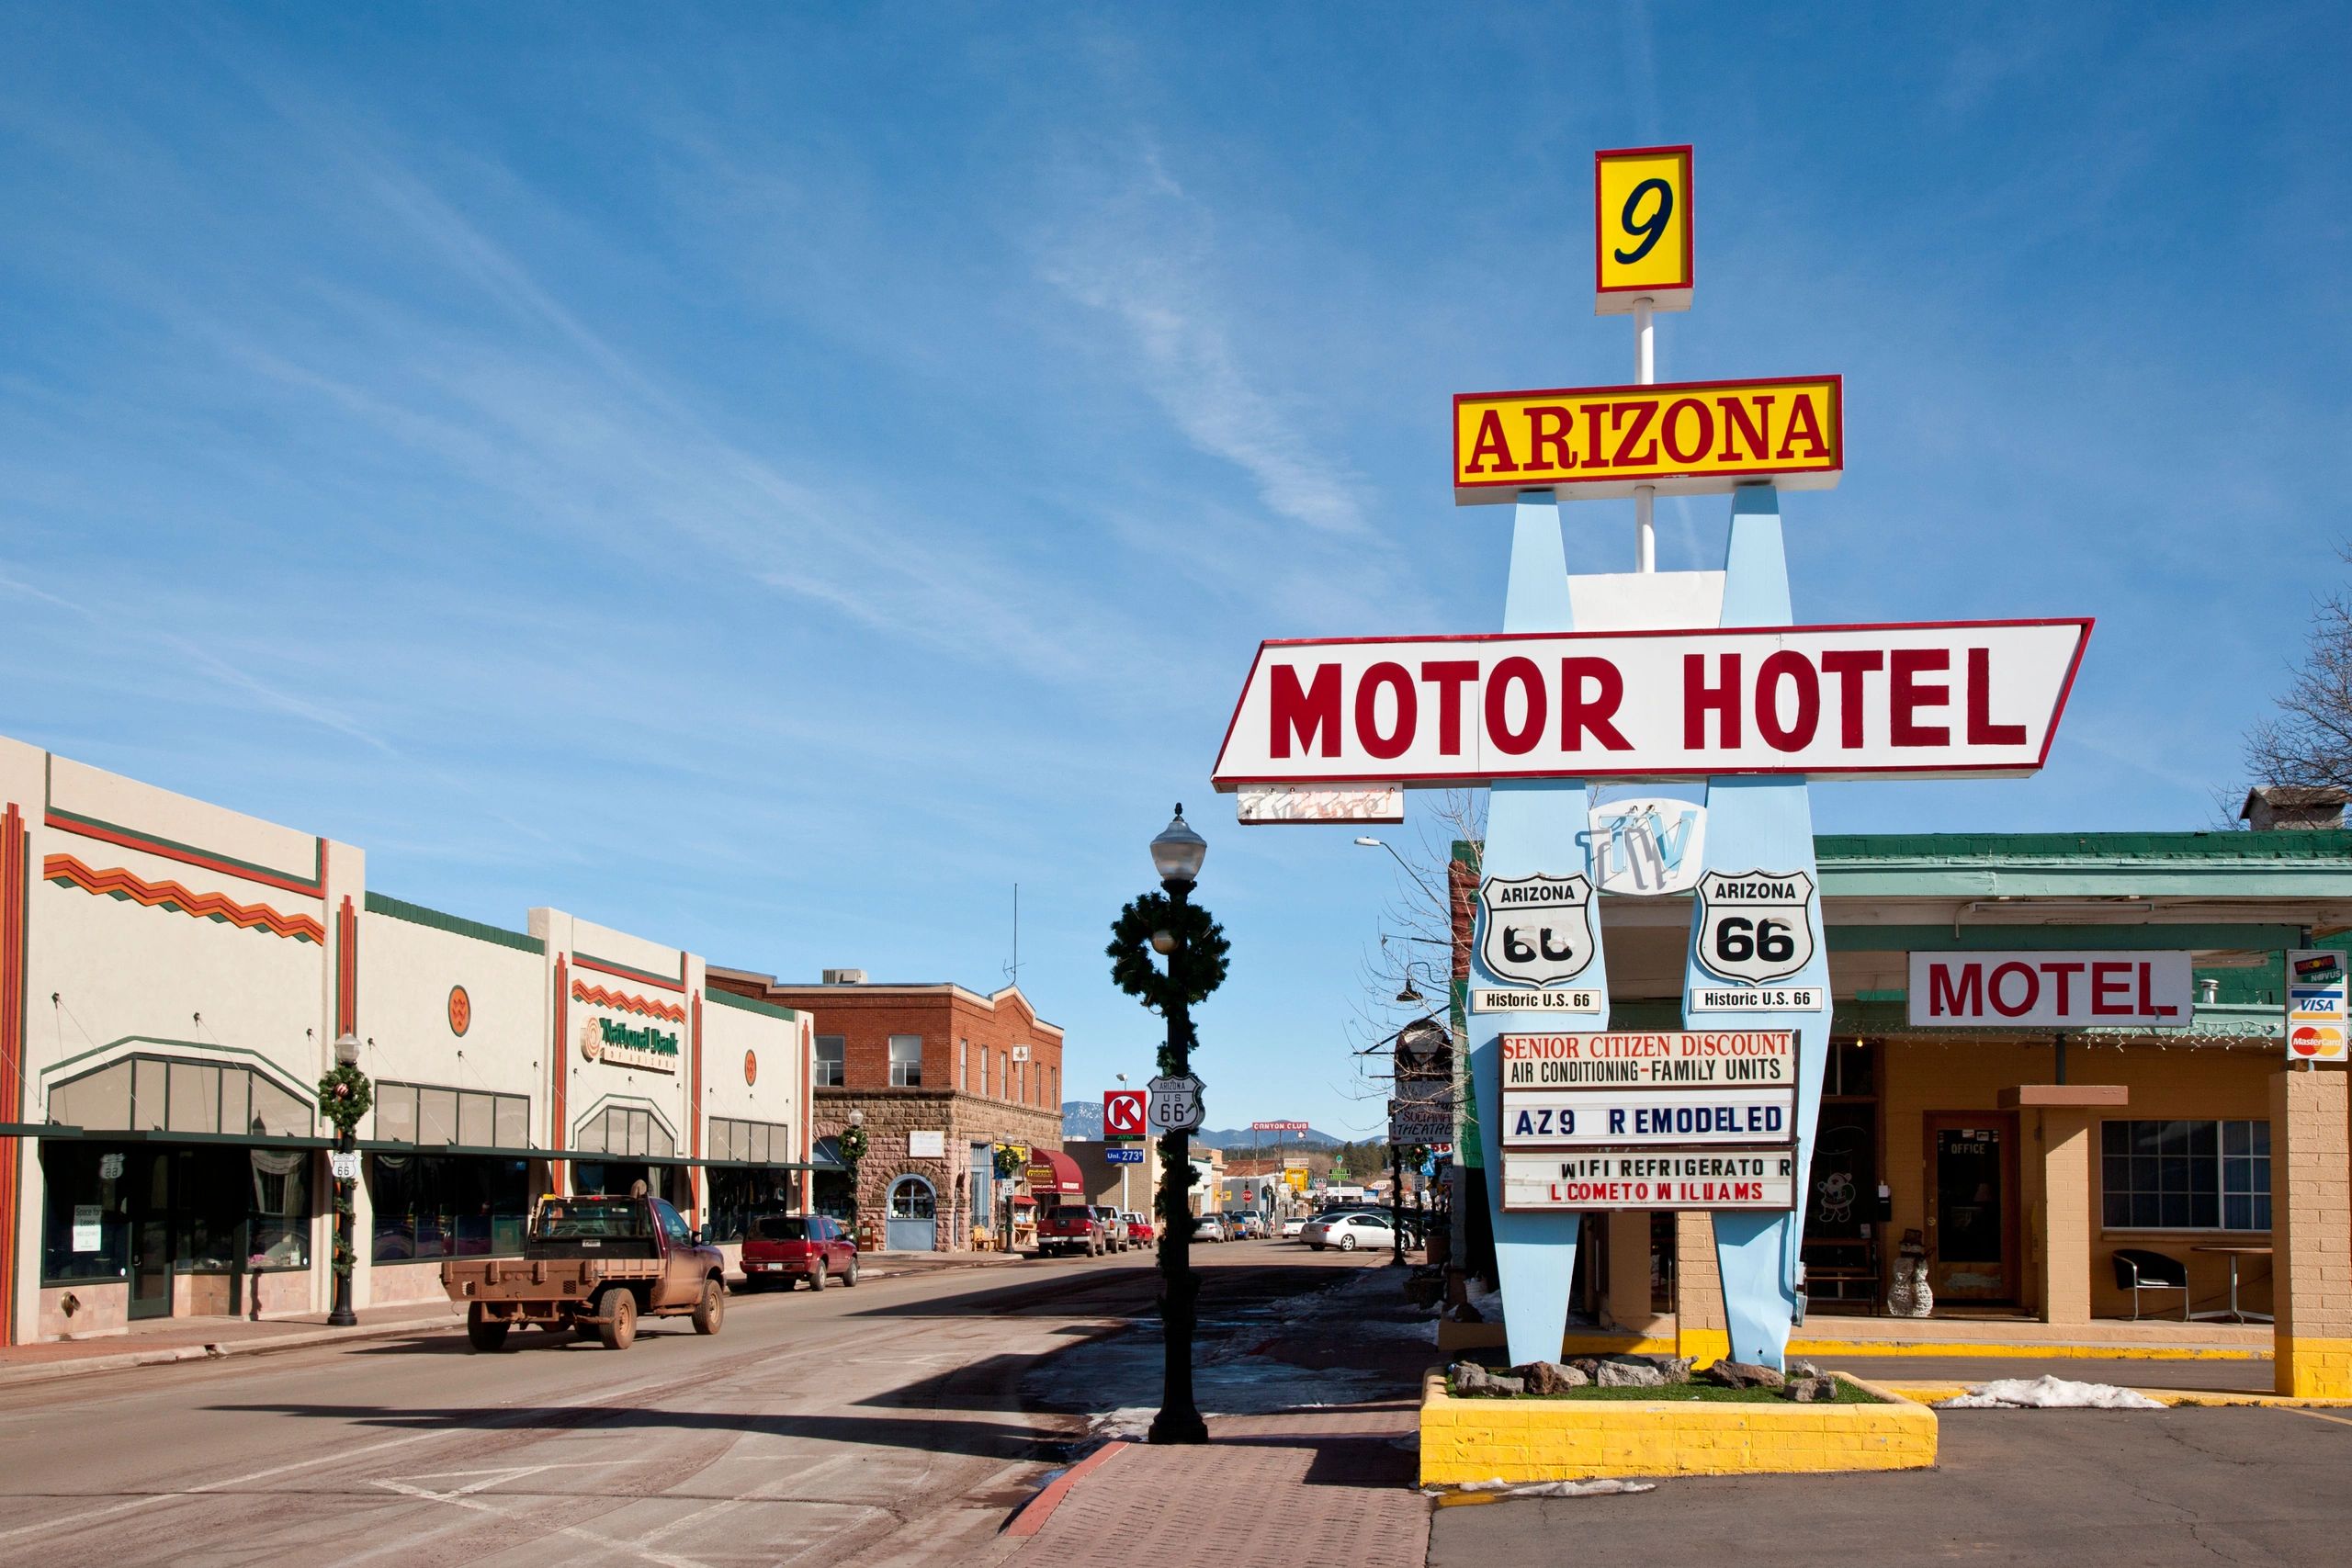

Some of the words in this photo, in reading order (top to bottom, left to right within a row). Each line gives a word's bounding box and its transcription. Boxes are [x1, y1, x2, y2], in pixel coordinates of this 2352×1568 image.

[1614, 178, 1673, 265] 9
[1464, 393, 1830, 474] ARIZONA
[1271, 656, 1635, 759] MOTOR
[1684, 648, 2027, 752] HOTEL
[1500, 886, 1575, 903] ARIZONA
[1714, 883, 1796, 899] ARIZONA
[1716, 917, 1794, 962] 66
[1705, 992, 1758, 1006] Historic
[1762, 992, 1789, 1006] U.S.
[1793, 992, 1811, 1005] 66
[1929, 961, 2177, 1017] MOTEL
[1487, 993, 1538, 1007] Historic
[1543, 993, 1568, 1007] U.S.
[1573, 993, 1589, 1007] 66
[2300, 999, 2335, 1011] VISA
[599, 1018, 650, 1050] National
[650, 1028, 679, 1055] Bank
[1503, 1037, 1579, 1059] SENIOR
[1589, 1035, 1671, 1057] CITIZEN
[1681, 1033, 1790, 1055] DISCOUNT
[2293, 1038, 2341, 1046] MasterCard
[1511, 1062, 1534, 1083] AIR
[1725, 1058, 1781, 1080] UNITS
[1159, 1082, 1185, 1090] ARIZONA
[1114, 1100, 1139, 1126] K
[1161, 1103, 1184, 1122] 66
[1515, 1109, 1576, 1135] AZ9
[1397, 1122, 1452, 1135] THEATRE
[1951, 1143, 1985, 1155] OFFICE
[337, 1167, 350, 1176] 66
[1562, 1159, 1610, 1180] WIFI
